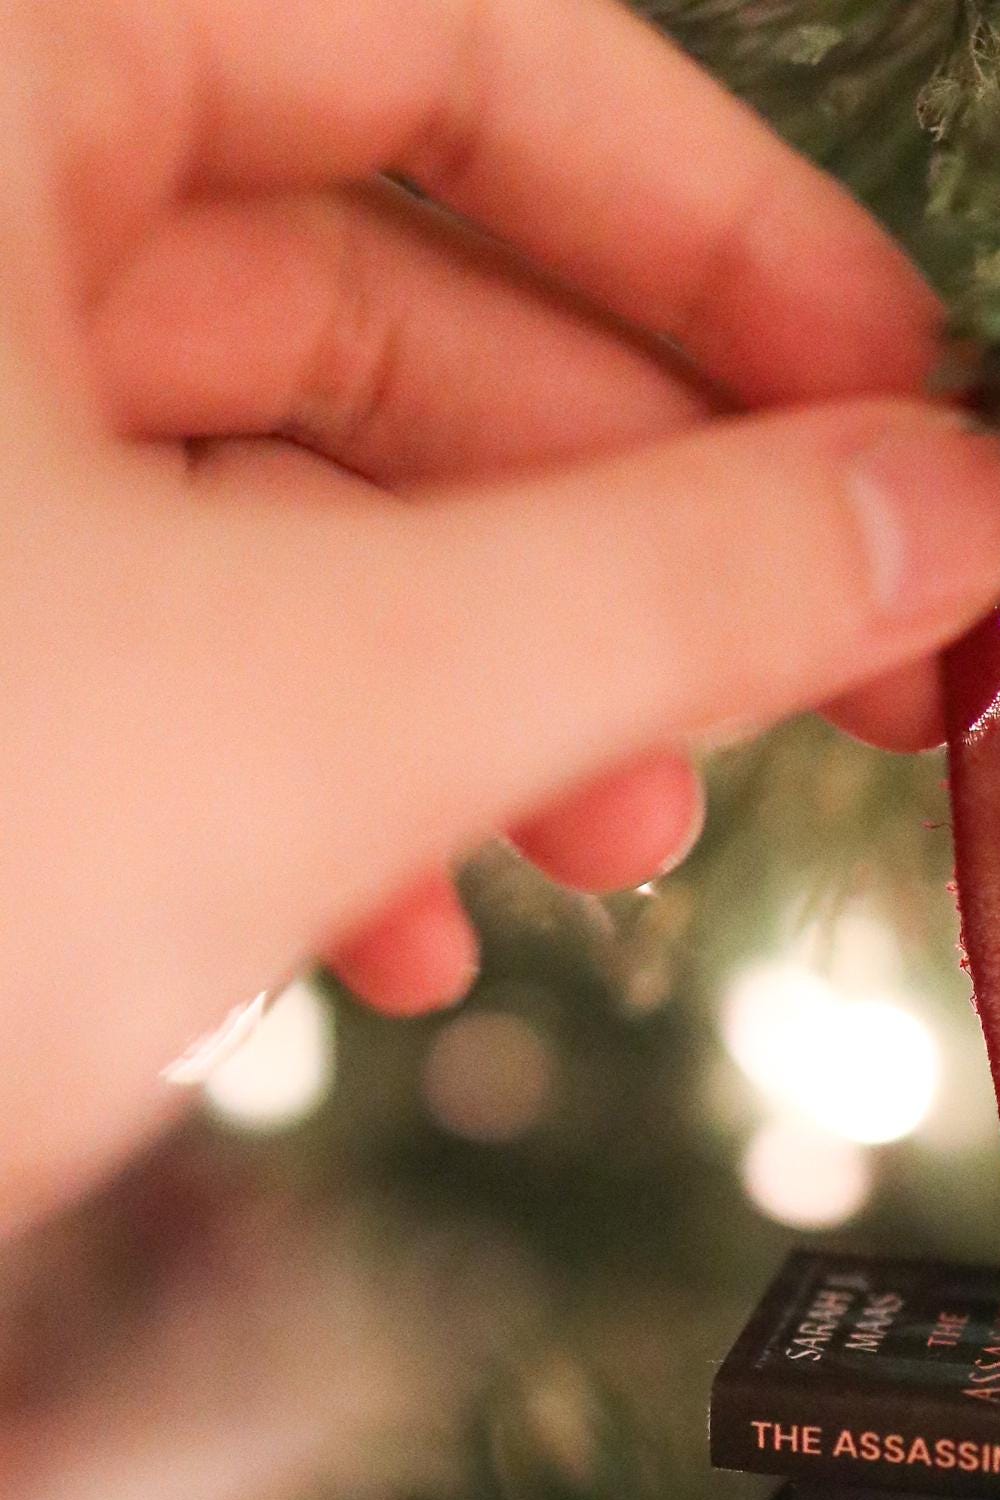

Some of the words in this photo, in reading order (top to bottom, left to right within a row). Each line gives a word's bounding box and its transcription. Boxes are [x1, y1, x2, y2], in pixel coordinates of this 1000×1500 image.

[785, 1289, 855, 1361] SARAH
[844, 1292, 904, 1353] MAAS
[927, 1311, 970, 1348] THE
[751, 1421, 821, 1454] THE
